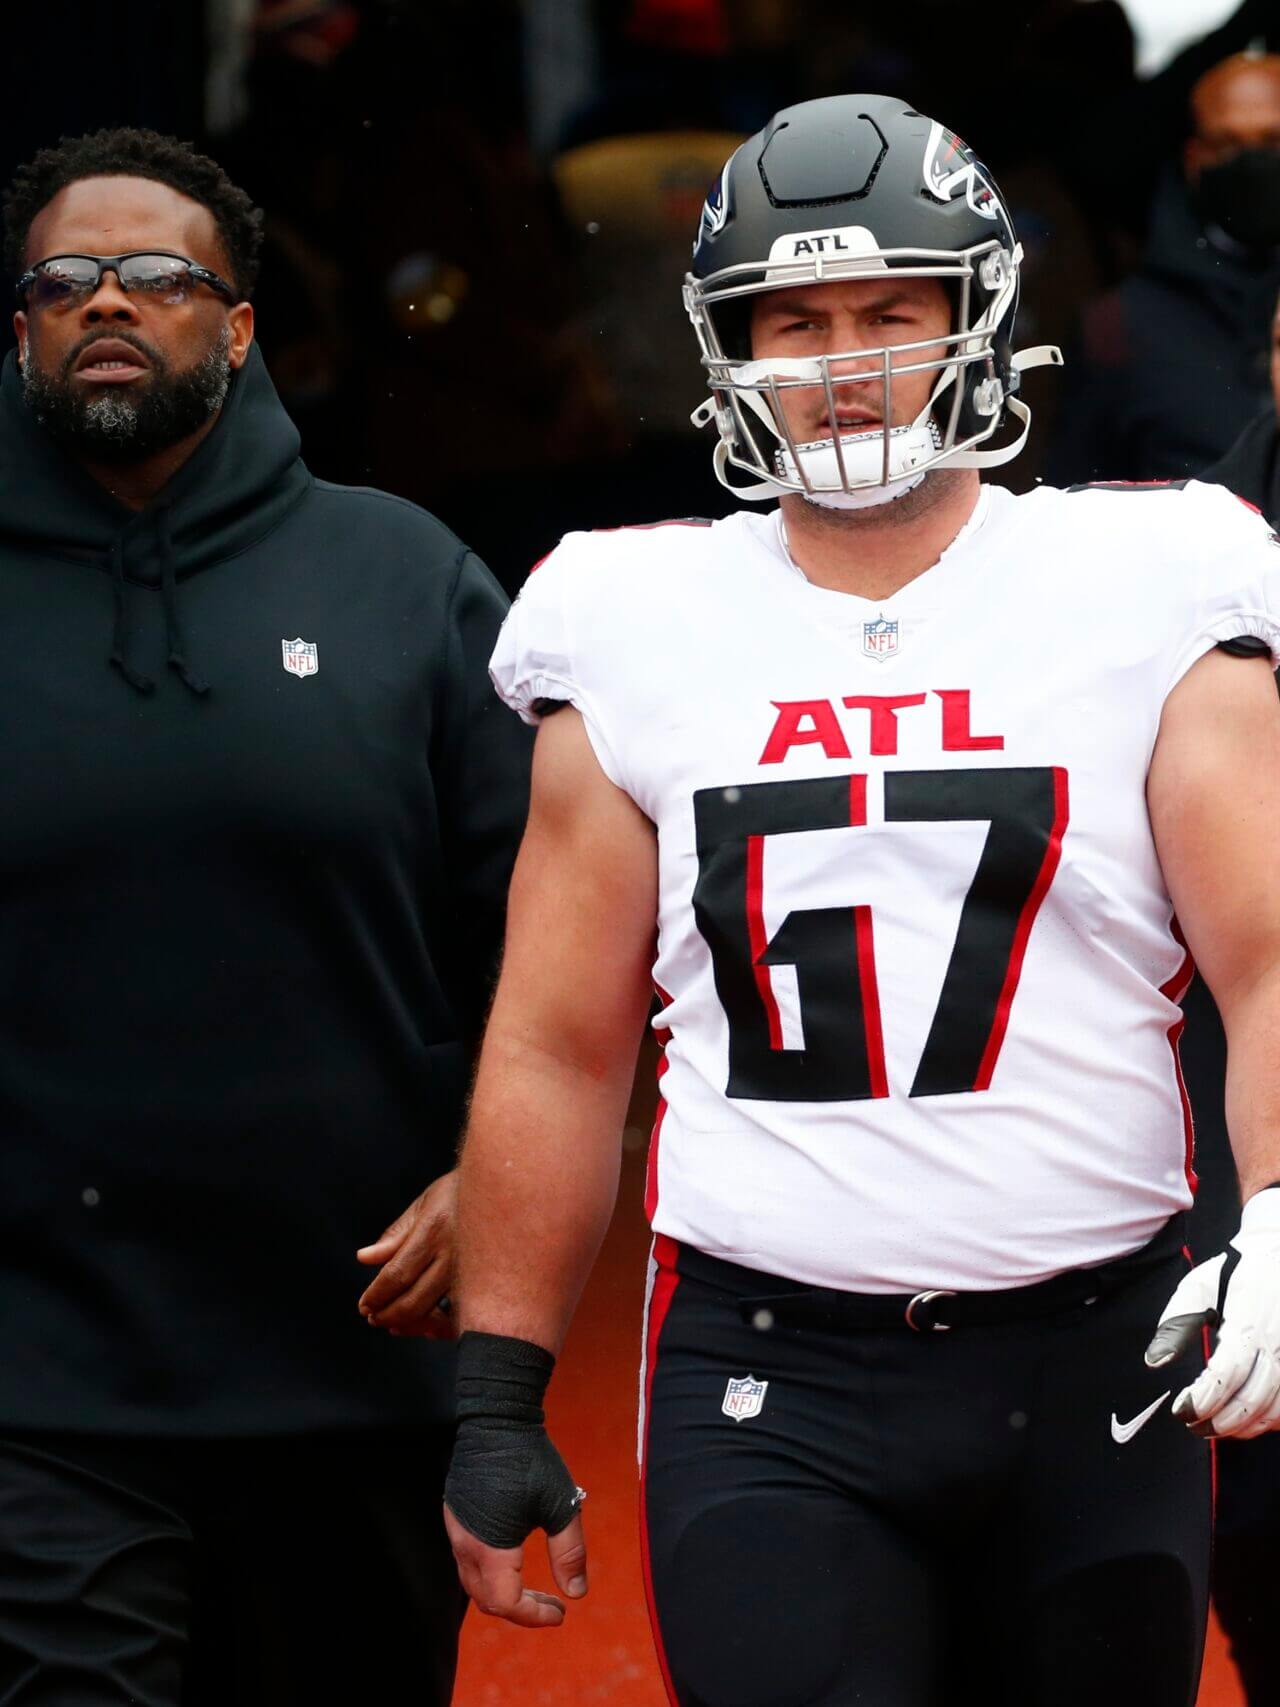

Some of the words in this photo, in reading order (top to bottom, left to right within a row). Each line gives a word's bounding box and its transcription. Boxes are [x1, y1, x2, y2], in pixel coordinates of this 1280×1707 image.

[794, 235, 848, 256] ATL
[868, 634, 895, 652] NFL
[287, 654, 314, 671] NFL
[758, 689, 1004, 765] ATL
[692, 766, 1069, 1102] 67
